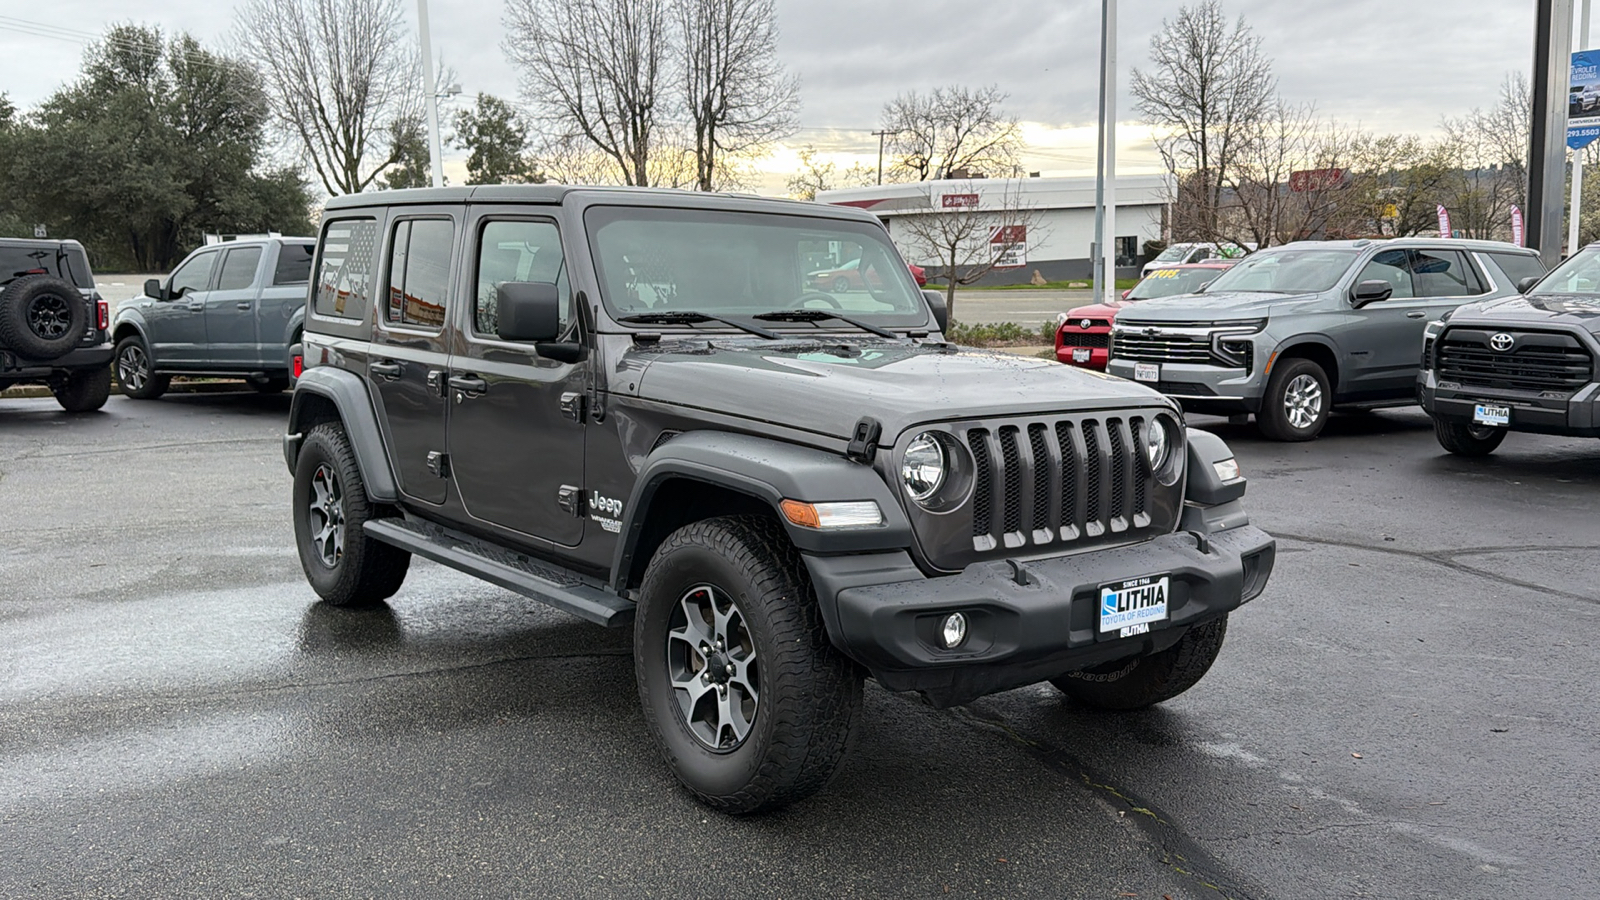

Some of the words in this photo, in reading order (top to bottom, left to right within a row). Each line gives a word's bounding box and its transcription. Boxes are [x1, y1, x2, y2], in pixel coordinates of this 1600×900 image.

[1571, 65, 1597, 75] EVROLET
[1572, 72, 1597, 80] REDDING
[1484, 407, 1508, 417] LITHIA
[589, 490, 623, 518] Jeep
[1122, 579, 1138, 589] SINCE
[1116, 584, 1165, 613] LITHIA
[1101, 613, 1126, 626] TOYOTA
[1126, 611, 1136, 621] OF
[1136, 604, 1165, 618] REDDING
[1126, 622, 1150, 636] LITHIA
